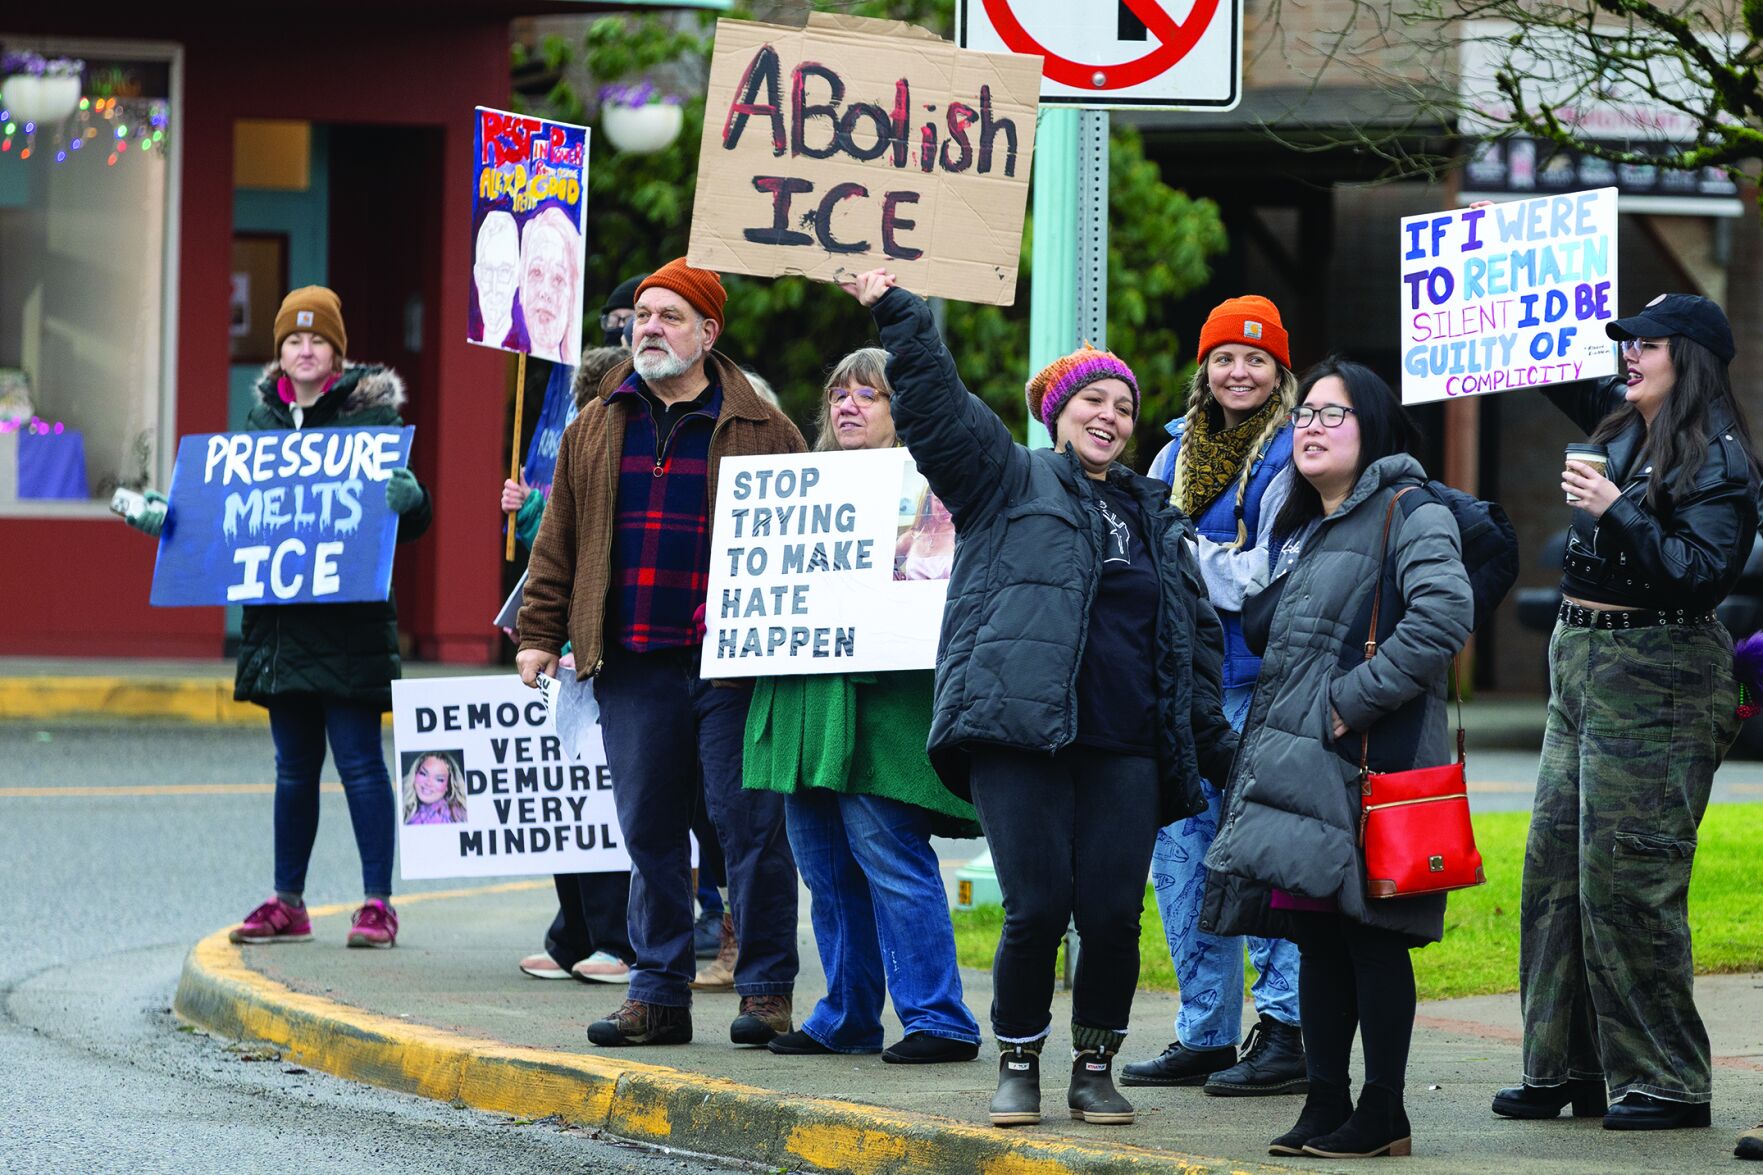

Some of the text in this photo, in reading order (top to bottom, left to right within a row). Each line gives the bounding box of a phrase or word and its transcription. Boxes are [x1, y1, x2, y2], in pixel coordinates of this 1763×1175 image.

[533, 139, 549, 160] IN
[743, 175, 924, 261] ICE
[1405, 193, 1599, 261] IF I WERE
[1404, 235, 1609, 310] TO REMAIN
[1412, 300, 1515, 342] SILENT
[1574, 281, 1612, 321] BE
[1405, 326, 1578, 379] GUILTY OF
[1446, 360, 1584, 396] COMPLICITY
[204, 431, 400, 486] PRESSURE
[733, 467, 820, 500] STOP
[222, 479, 364, 541] MELTS
[731, 503, 857, 538] TRYING
[226, 538, 345, 601] ICE
[727, 539, 874, 577] TO MAKE
[720, 585, 810, 619] HATE
[717, 626, 856, 659] HAPPEN
[415, 701, 601, 733] DEMOC
[490, 735, 581, 764] VER
[466, 764, 613, 795] DEMURE
[493, 796, 588, 824] VERY
[459, 824, 617, 857] MINDFUL
